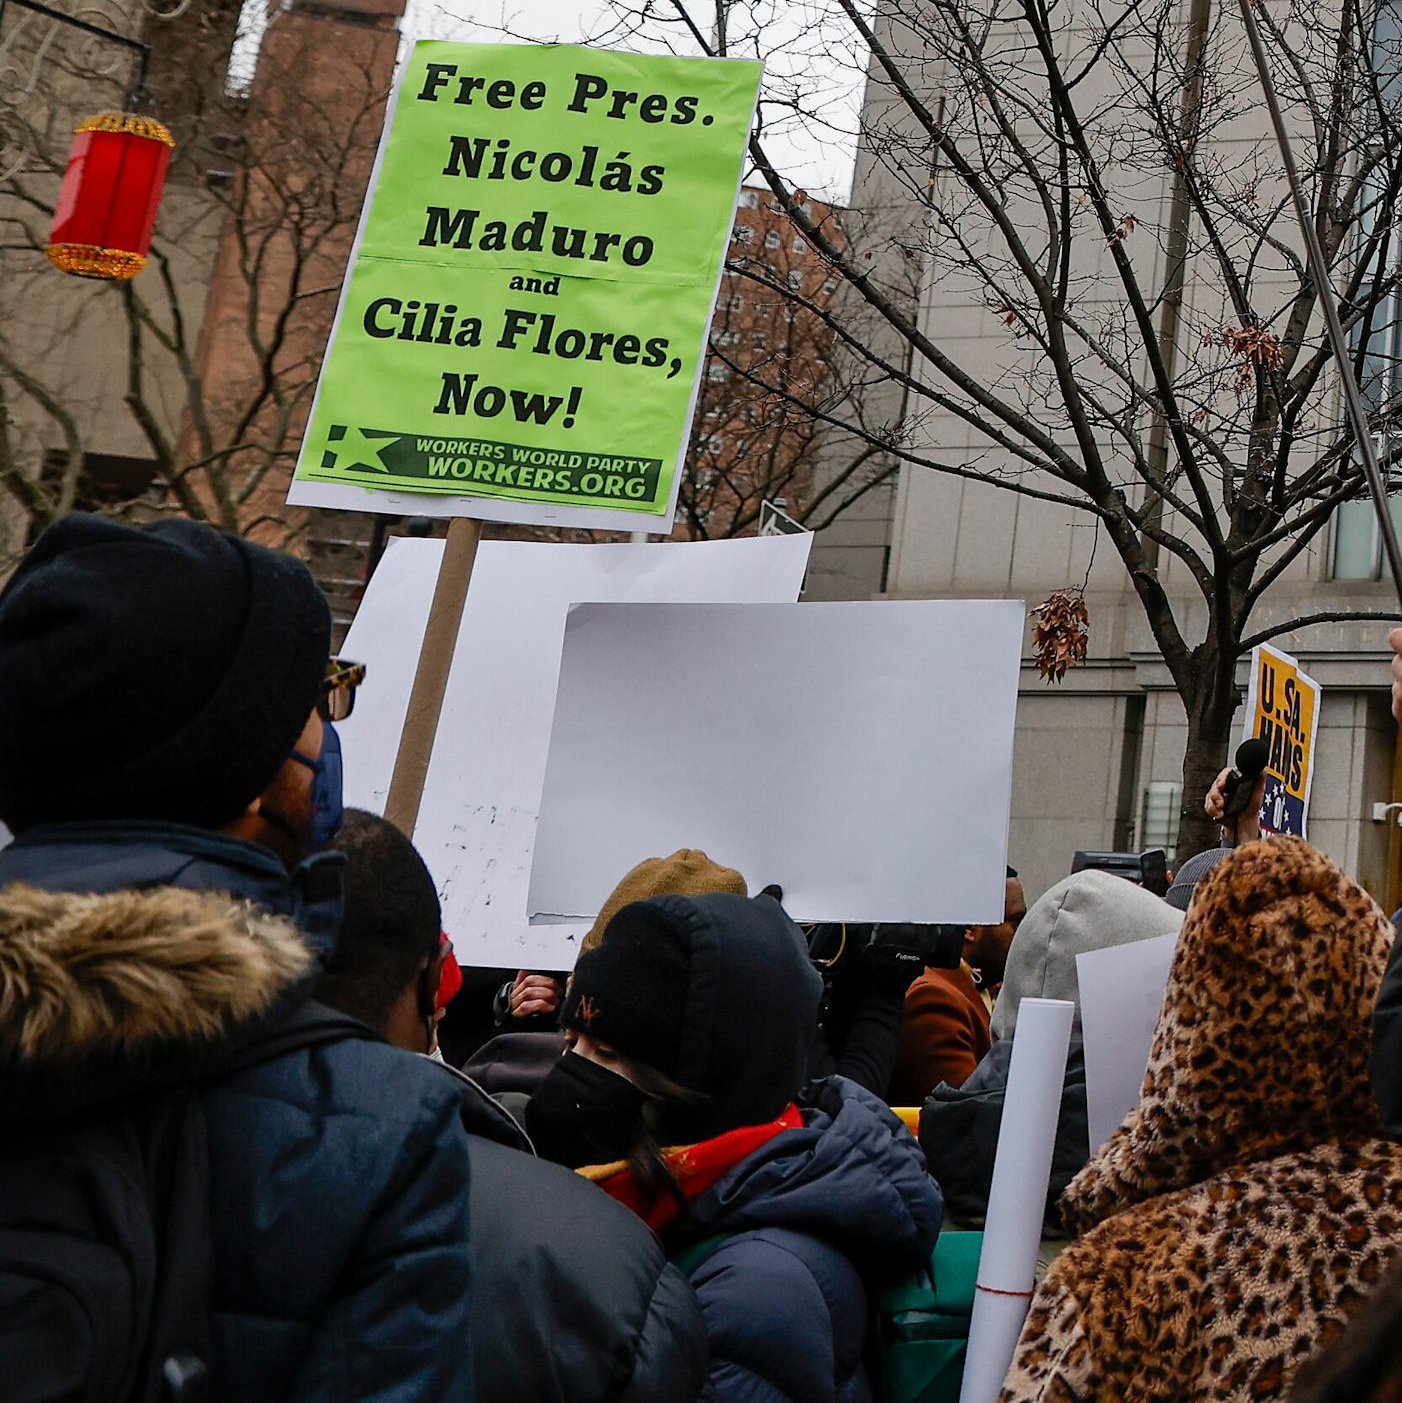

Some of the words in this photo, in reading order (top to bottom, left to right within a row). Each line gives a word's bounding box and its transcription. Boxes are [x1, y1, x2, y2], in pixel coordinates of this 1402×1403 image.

[416, 63, 547, 110] Free
[566, 72, 715, 126] Pres.
[442, 135, 665, 195] Nicolás
[418, 206, 654, 267] Maduro
[508, 272, 561, 296] and
[362, 297, 483, 348] Cilia
[495, 308, 683, 380] Flores,
[432, 372, 584, 429] Now!
[416, 438, 506, 459] WORKERS
[512, 448, 582, 468] WORLD
[586, 456, 652, 474] PARTY
[427, 455, 646, 498] WORKERS.ORG
